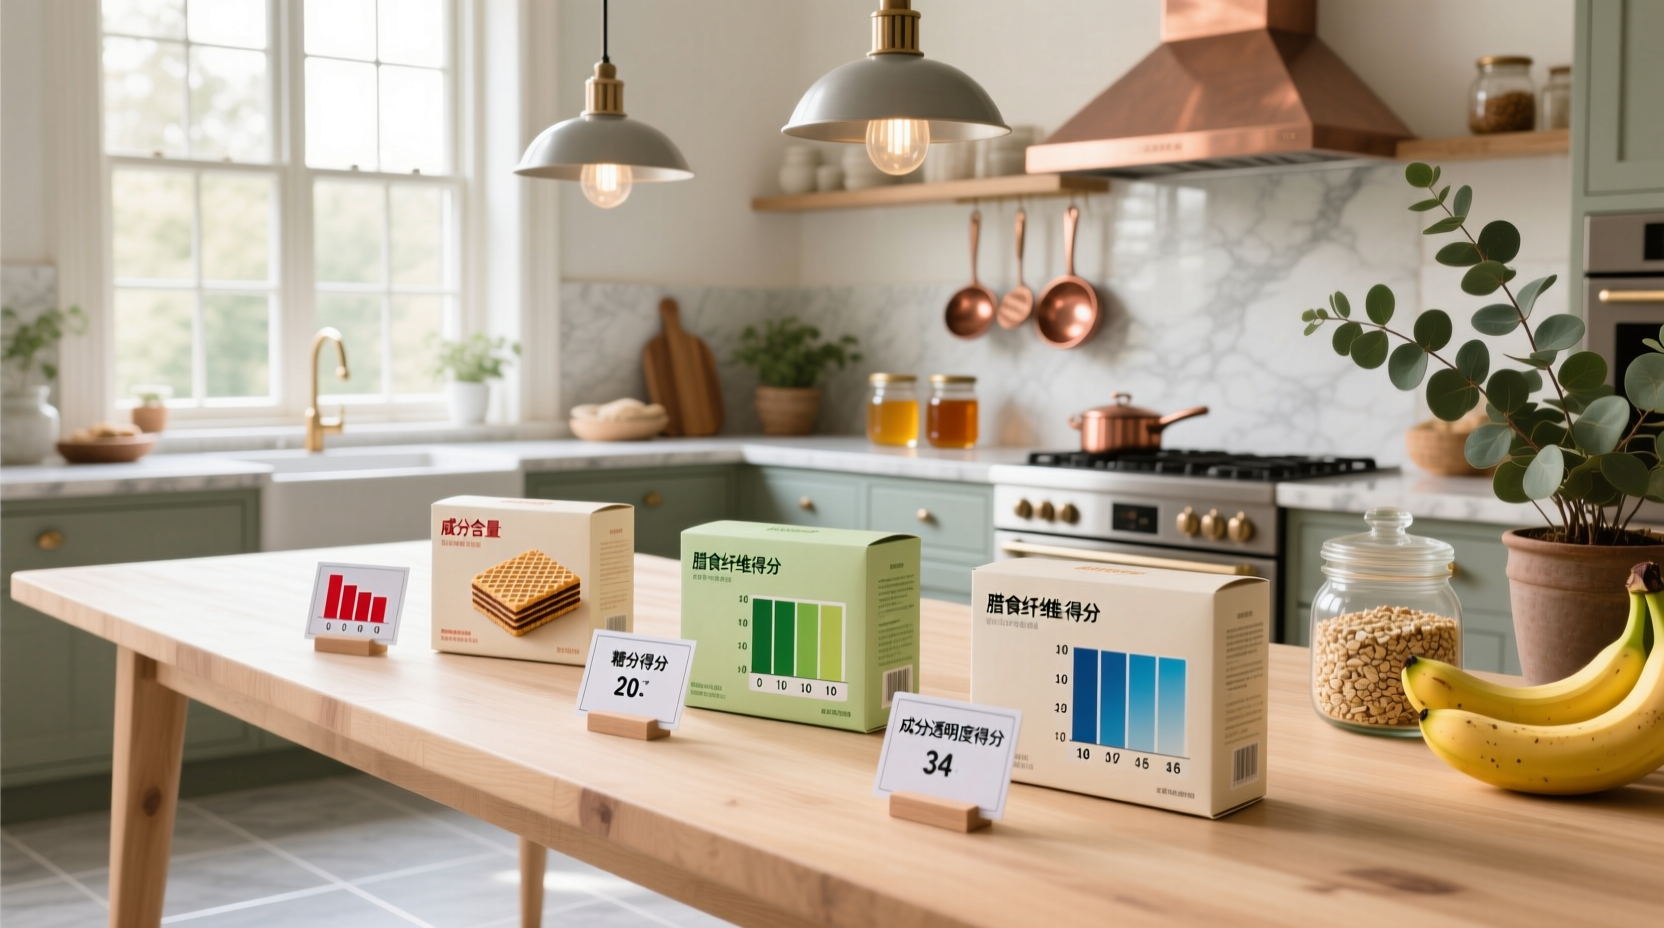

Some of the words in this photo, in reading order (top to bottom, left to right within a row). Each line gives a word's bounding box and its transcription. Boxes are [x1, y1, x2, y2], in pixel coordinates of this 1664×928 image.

[326, 622, 331, 631] 0
[342, 623, 347, 632] 0
[756, 677, 763, 688] 0
[777, 680, 787, 690] 10
[801, 682, 812, 694] 10
[826, 685, 837, 696] 10
[922, 750, 954, 778] 34
